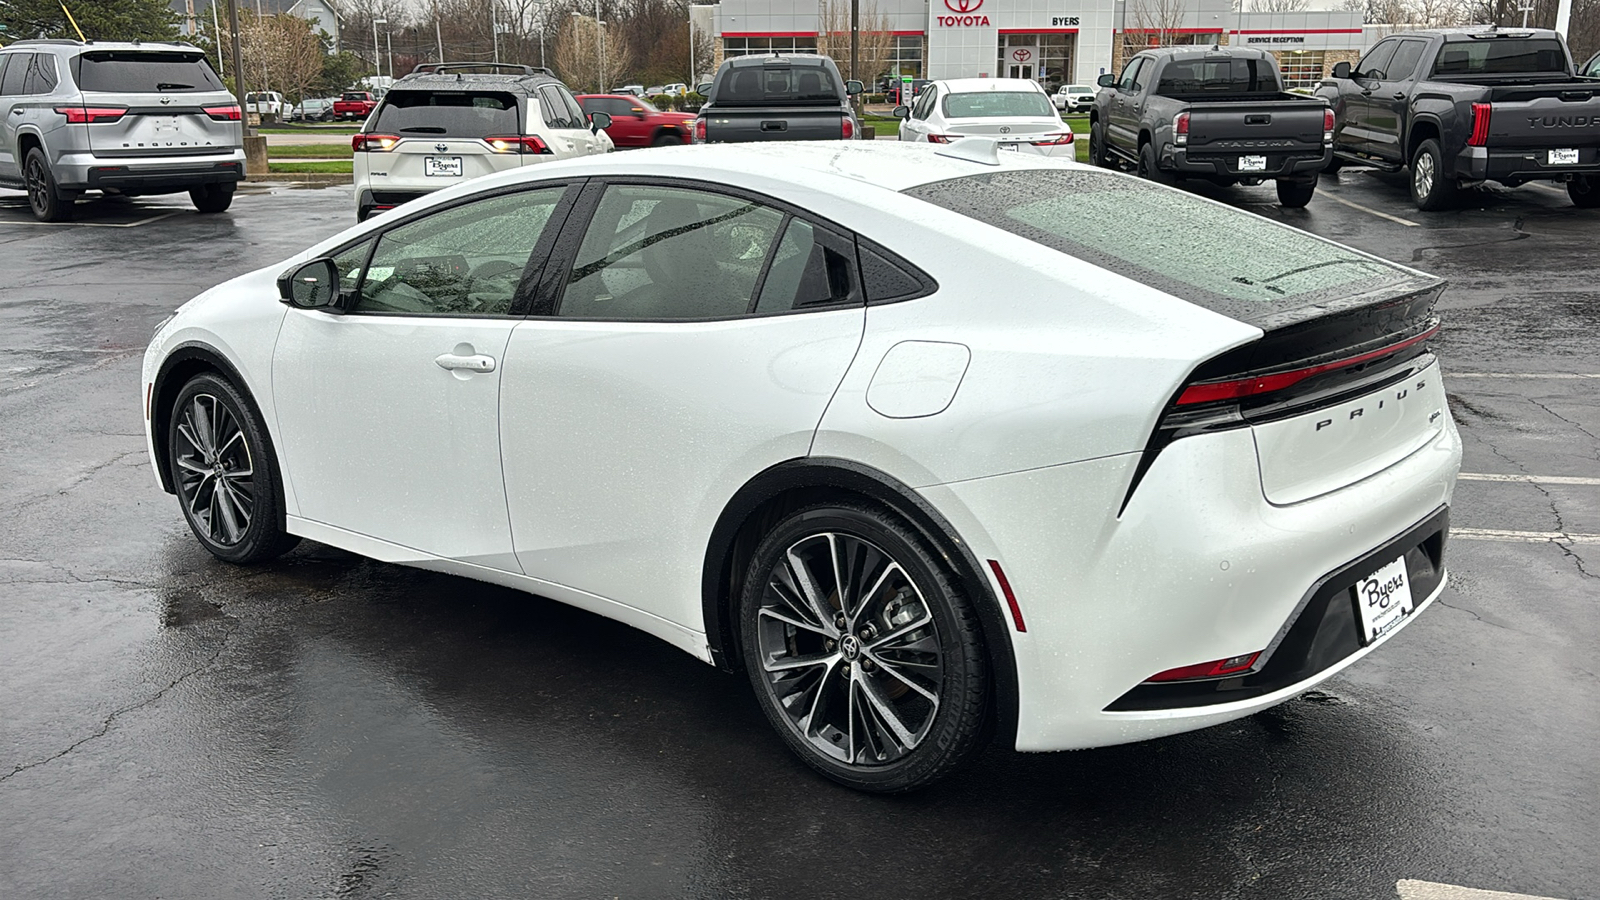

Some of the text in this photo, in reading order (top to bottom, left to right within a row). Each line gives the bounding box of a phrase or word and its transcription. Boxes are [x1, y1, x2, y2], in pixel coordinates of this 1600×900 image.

[937, 16, 990, 27] TOYOTA
[1052, 17, 1080, 26] BYERS
[1217, 140, 1294, 148] TACOMA
[428, 160, 459, 171] Byers
[1315, 379, 1426, 432] PRIUS
[1361, 573, 1404, 609] Byers
